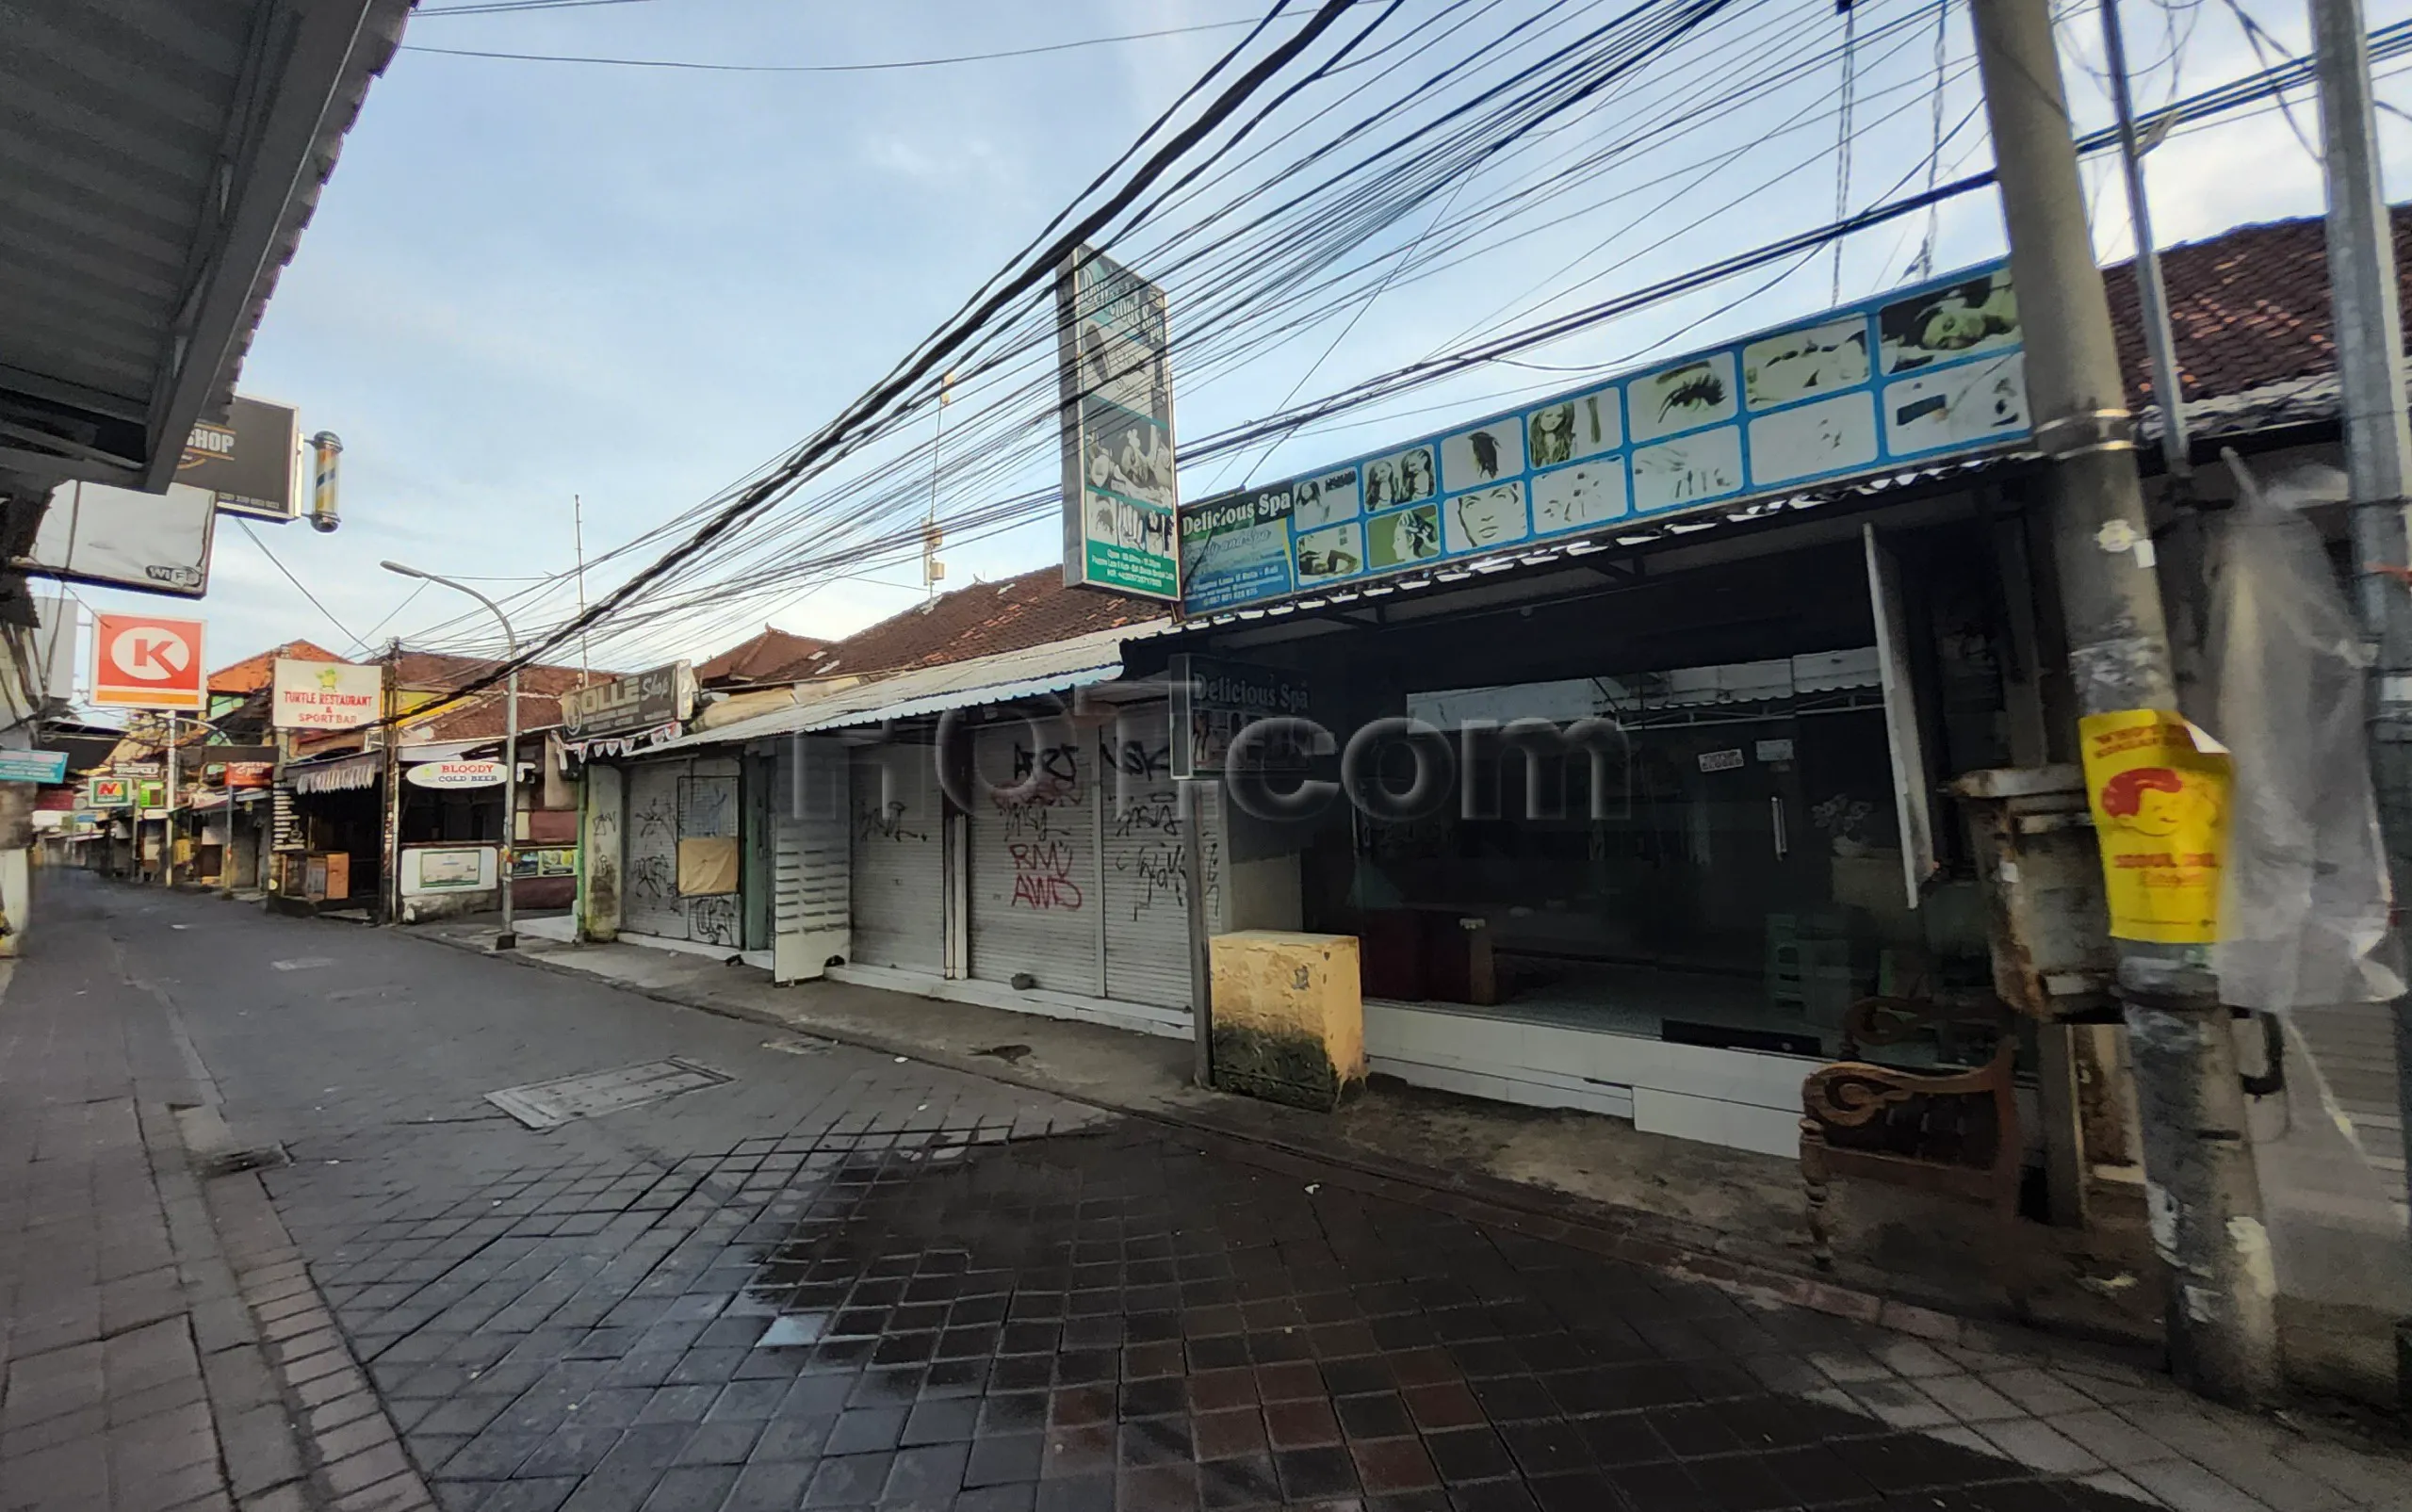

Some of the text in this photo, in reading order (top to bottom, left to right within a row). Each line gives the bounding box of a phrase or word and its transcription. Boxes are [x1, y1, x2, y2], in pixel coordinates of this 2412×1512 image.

[1182, 491, 1291, 537] Delicious Spa
[134, 639, 178, 678] K
[284, 691, 373, 707] TURTLE RESTAURANT
[580, 676, 640, 715] OLLE
[1193, 672, 1310, 713] Delicious Spa
[298, 713, 358, 724] SPORT BAR
[438, 774, 467, 784] COLD
[470, 774, 497, 783] BEER
[441, 764, 495, 774] BLOODY
